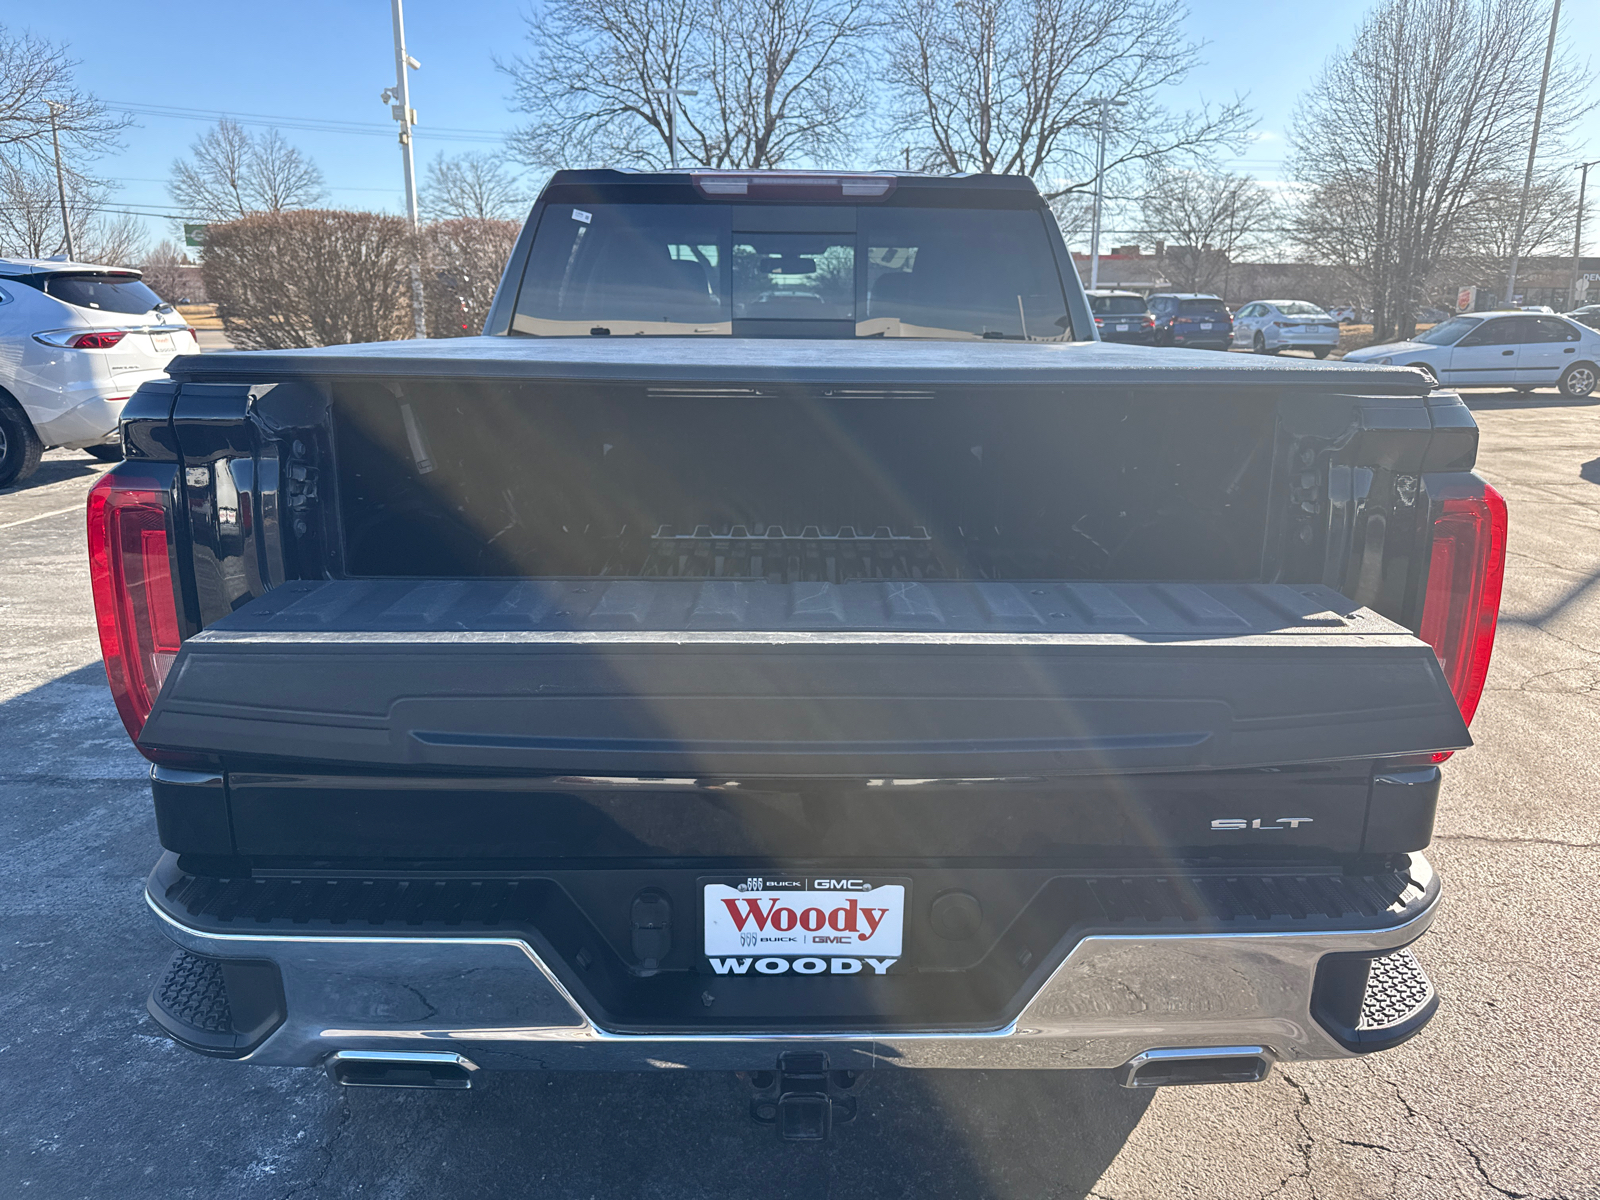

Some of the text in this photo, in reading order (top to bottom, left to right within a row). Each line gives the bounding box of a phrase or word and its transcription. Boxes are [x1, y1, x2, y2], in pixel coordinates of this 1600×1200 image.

[1211, 818, 1313, 830] SLT
[814, 879, 863, 889] GMC
[721, 898, 889, 941] Woody
[812, 936, 851, 944] GMC
[709, 957, 897, 974] WOODY
